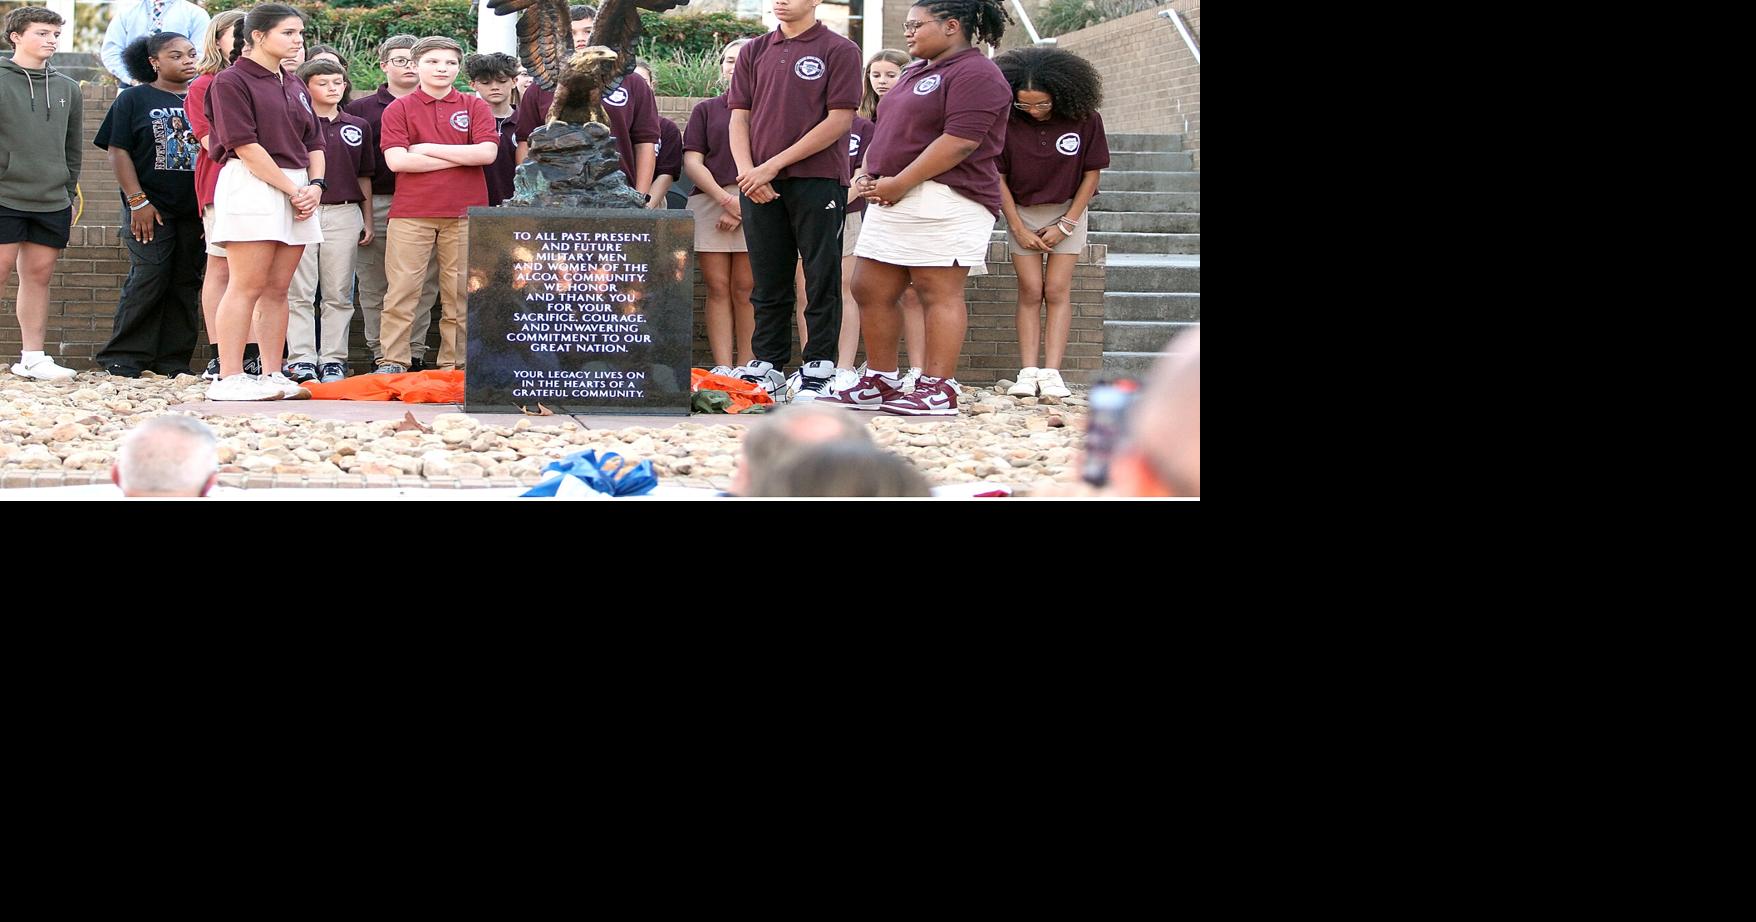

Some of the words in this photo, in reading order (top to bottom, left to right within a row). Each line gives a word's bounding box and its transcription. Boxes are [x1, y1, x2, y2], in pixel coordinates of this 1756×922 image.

[513, 232, 531, 241] TO
[535, 232, 558, 241] ALL
[541, 242, 570, 251] AND
[574, 243, 622, 252] FUTURE
[536, 253, 593, 261] MILITARY
[598, 253, 627, 262] MEN
[514, 262, 543, 271] AND
[548, 263, 598, 272] WOMEN
[602, 263, 619, 272] OF
[623, 264, 648, 272] THE
[516, 273, 559, 281] ALCOA
[544, 283, 565, 292] WE
[568, 283, 618, 292] HONOR
[526, 293, 555, 302] AND
[559, 293, 604, 302] THANK
[609, 294, 635, 302] YOU
[547, 303, 573, 312] FOR
[578, 304, 612, 312] YOUR
[521, 323, 550, 332] AND
[554, 324, 639, 333] UNWAVERING
[506, 333, 597, 342] COMMITMENT
[602, 334, 620, 343] TO
[624, 334, 652, 343] OUR
[530, 343, 572, 352] GREAT
[576, 344, 629, 353] NATION.
[513, 370, 544, 379] YOUR
[548, 371, 590, 379] LEGACY
[594, 371, 623, 379] LIVES
[626, 371, 645, 380] ON
[522, 380, 534, 388] IN
[538, 380, 559, 388] THE
[564, 380, 606, 388] HEARTS
[609, 380, 624, 389] OF
[628, 380, 636, 389] A
[512, 388, 568, 397] GRATEFUL
[572, 389, 645, 398] COMMUNITY.
